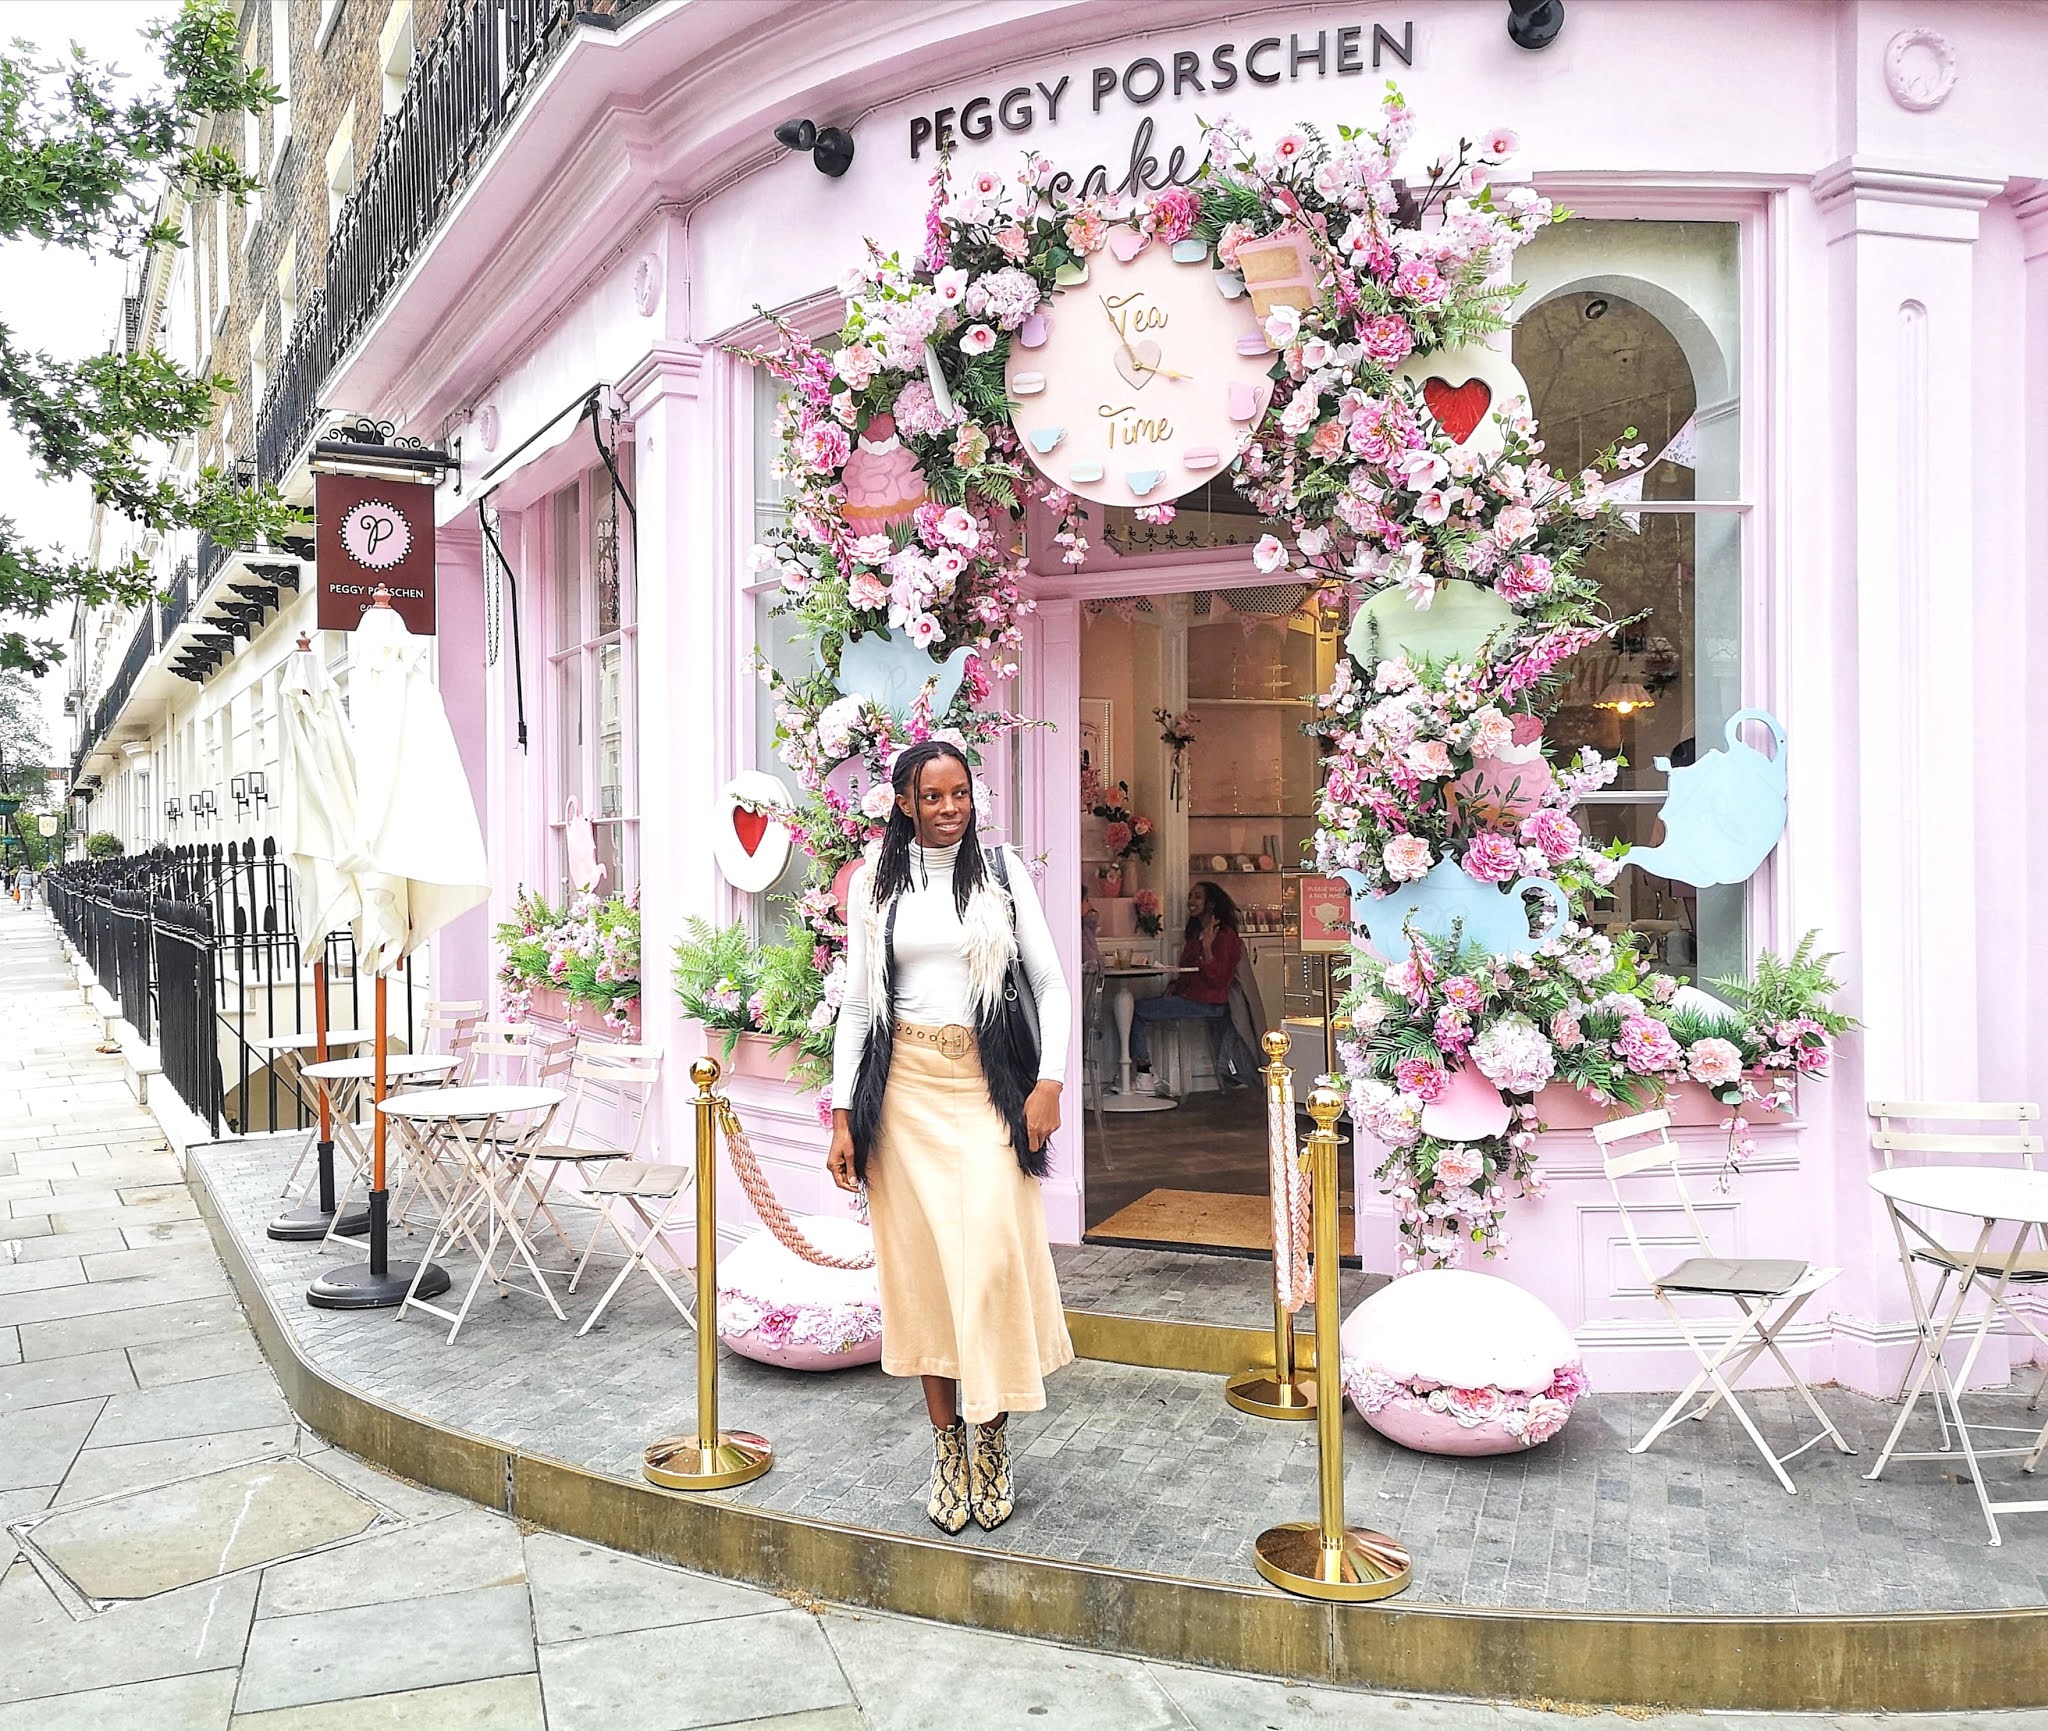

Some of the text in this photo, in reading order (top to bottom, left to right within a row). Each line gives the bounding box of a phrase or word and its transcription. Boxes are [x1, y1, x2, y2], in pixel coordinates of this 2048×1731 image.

[910, 20, 1413, 159] PEGGY PORSCHEN
[1048, 116, 1212, 210] cake
[1106, 292, 1168, 337] Tea
[1098, 404, 1174, 449] Time
[361, 515, 394, 555] P
[329, 584, 365, 594] PEGGY
